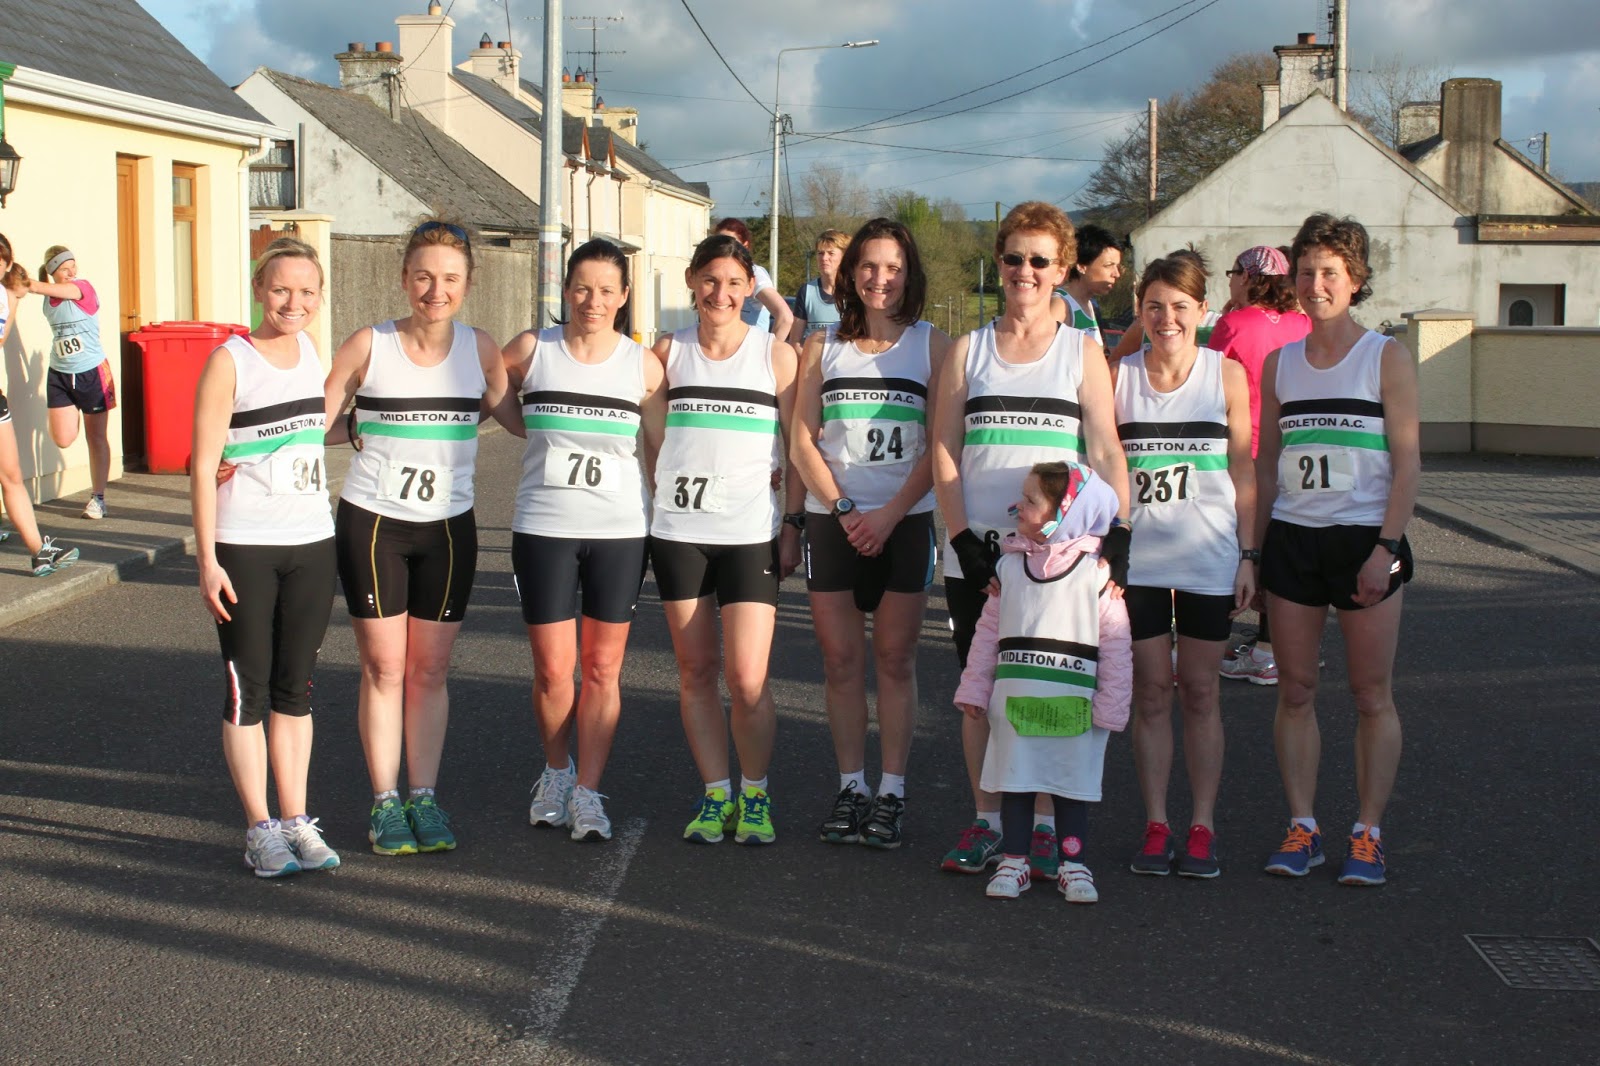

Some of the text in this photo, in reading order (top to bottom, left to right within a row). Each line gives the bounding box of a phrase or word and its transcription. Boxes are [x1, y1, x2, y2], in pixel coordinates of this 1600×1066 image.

[59, 337, 81, 356] 189
[825, 391, 915, 405] MIDLETON A.C.
[380, 412, 472, 422] MIDLETON A.C.
[534, 404, 630, 420] MIDLETON A.C.
[671, 403, 758, 415] MIDLETON A.C.
[257, 418, 317, 438] MIDLETON
[970, 416, 1066, 428] MIDLETON A.C.
[1280, 417, 1365, 430] MIDLETON A.C.
[867, 426, 904, 463] 24
[1188, 442, 1212, 452] A.C.
[567, 452, 603, 487] 76
[1298, 454, 1331, 490] 21
[399, 466, 437, 502] 78
[674, 476, 709, 510] 37
[1135, 465, 1190, 504] 237
[1000, 651, 1086, 672] MIDLETON A.C.
